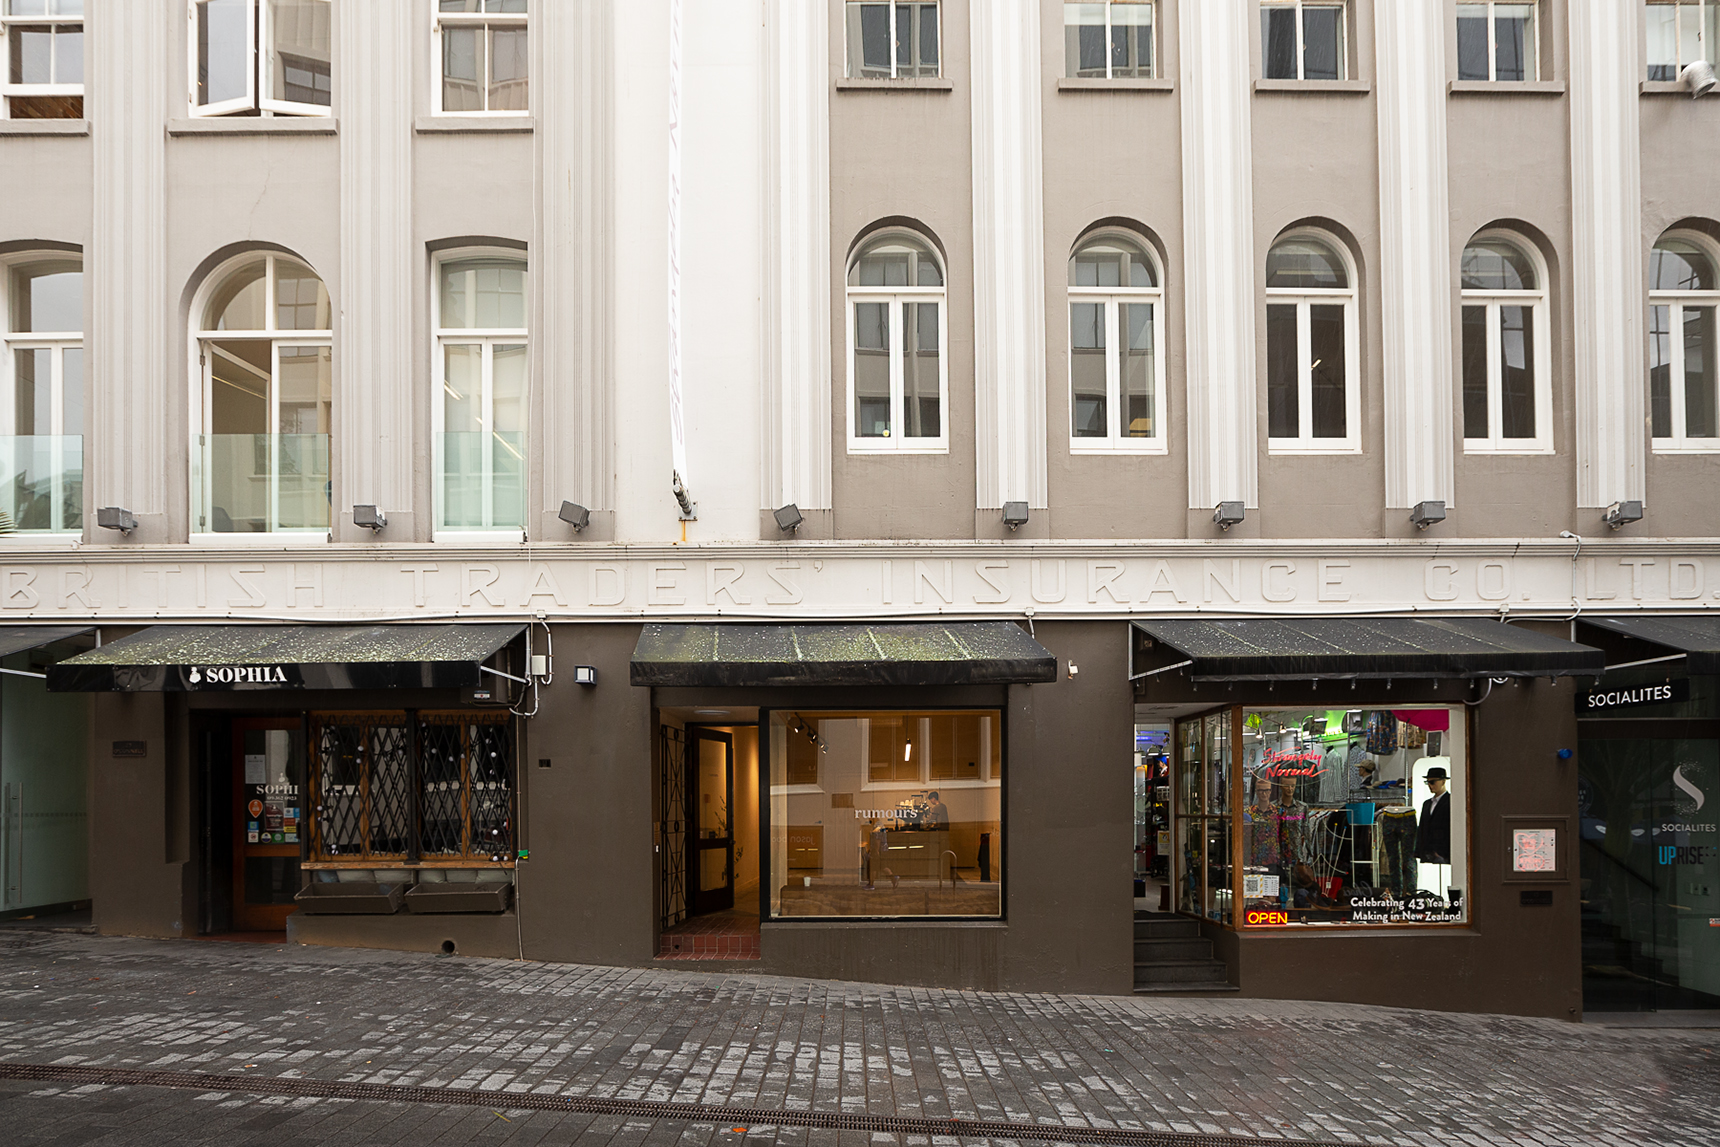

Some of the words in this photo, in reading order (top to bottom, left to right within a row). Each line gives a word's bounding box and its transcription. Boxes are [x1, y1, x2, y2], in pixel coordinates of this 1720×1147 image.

[3, 563, 324, 608] BRITISH
[400, 560, 823, 607] TRADERS'
[881, 558, 1352, 604] INSURANCE
[1424, 559, 1531, 602] CO.
[206, 666, 287, 683] SOPHIA
[1588, 685, 1672, 708] SOCIALITES
[1261, 746, 1322, 767] Strangely
[1265, 763, 1329, 779] Normal
[256, 784, 299, 795] SOPHI
[854, 809, 918, 819] rumours
[1661, 823, 1717, 832] SOCIALITES
[1658, 846, 1704, 865] UPRISE
[1350, 897, 1405, 910] Celebrating
[1408, 898, 1425, 910] 43
[1453, 897, 1463, 907] of
[1248, 912, 1288, 924] OPEN
[1353, 911, 1388, 924] Making
[1390, 911, 1400, 920] in
[1402, 911, 1423, 920] New
[1425, 911, 1462, 921] Zealand
